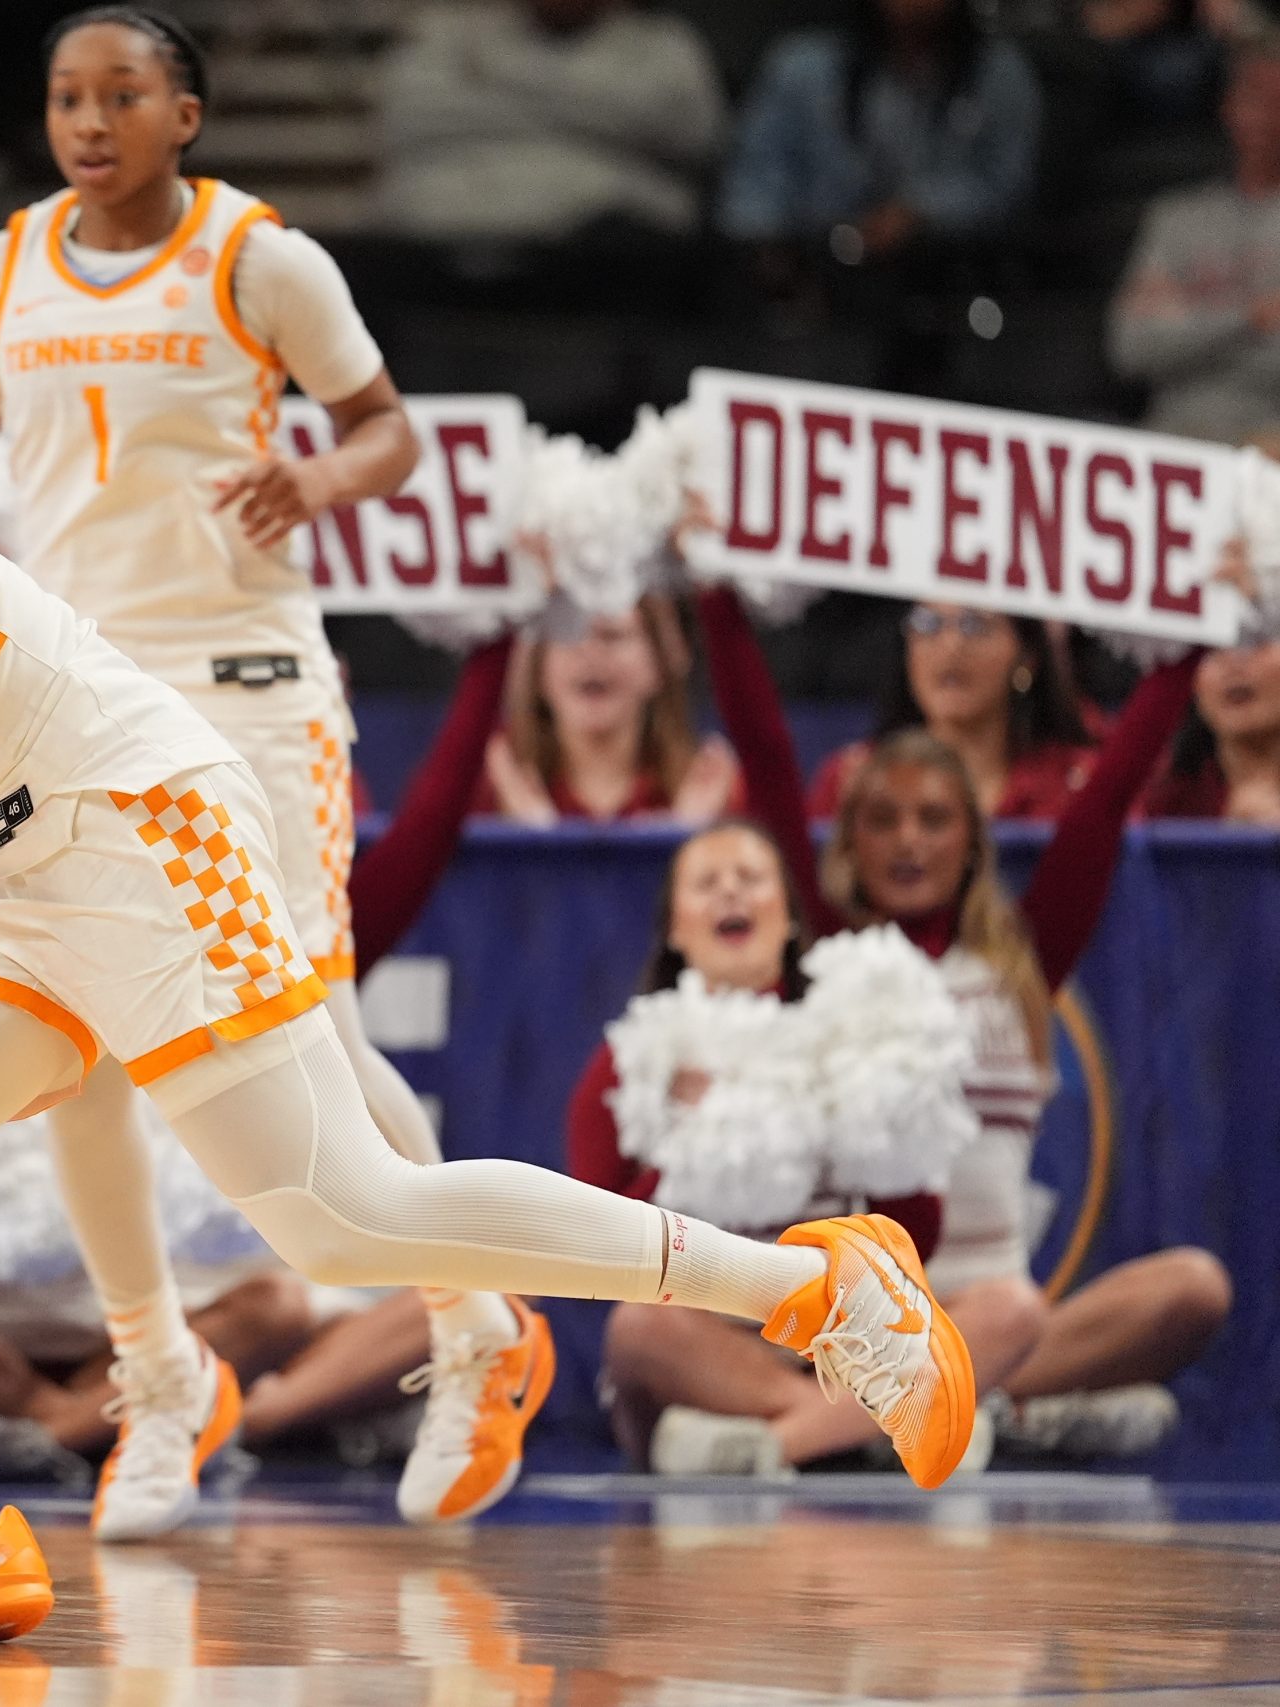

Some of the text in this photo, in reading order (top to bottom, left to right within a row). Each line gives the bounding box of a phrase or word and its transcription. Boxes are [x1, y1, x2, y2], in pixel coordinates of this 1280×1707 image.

[5, 332, 209, 375] TENNESSEE
[82, 384, 110, 484] 1
[726, 399, 1203, 616] DEFENSE
[8, 800, 20, 816] 46
